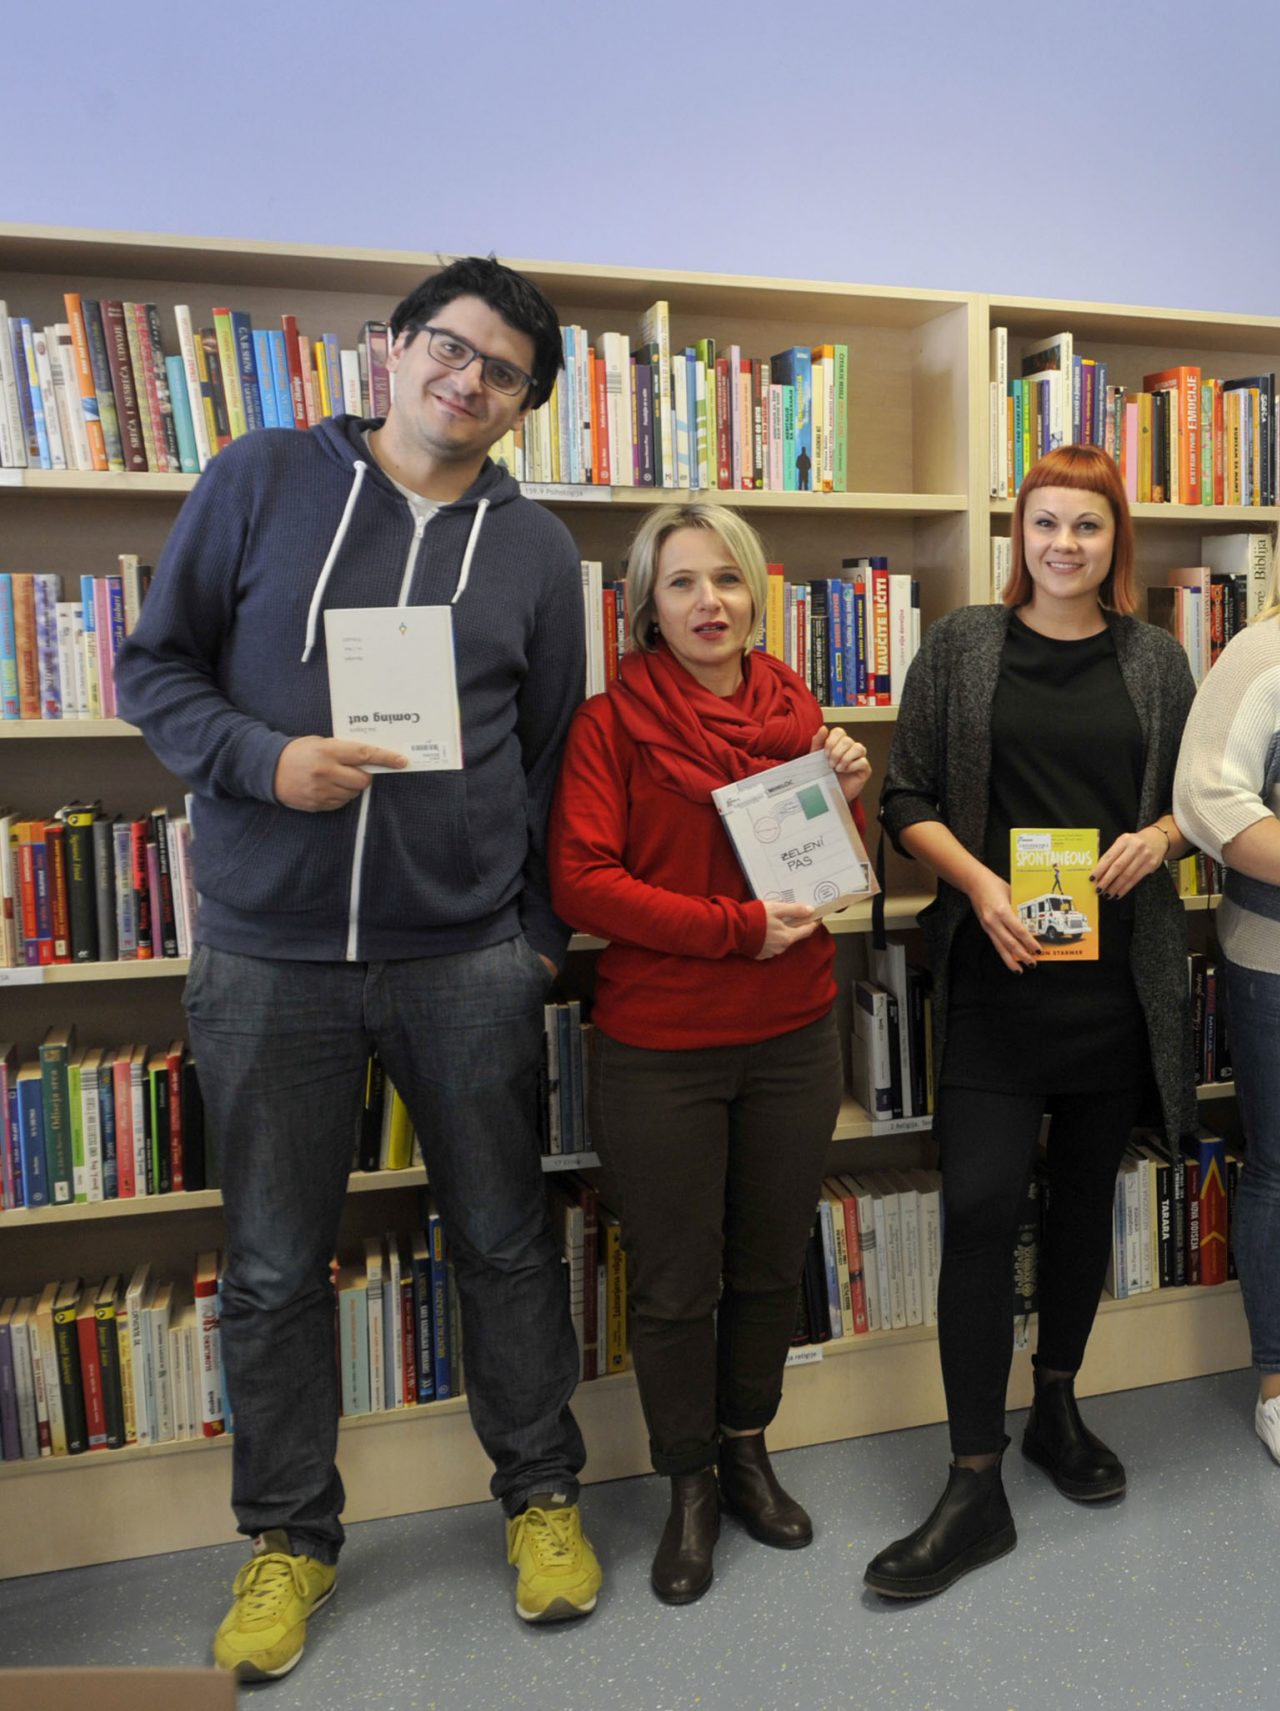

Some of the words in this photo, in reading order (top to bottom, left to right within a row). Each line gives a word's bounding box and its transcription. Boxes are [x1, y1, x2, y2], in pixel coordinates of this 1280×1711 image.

[118, 365, 132, 407] NESREĆA
[1187, 375, 1197, 430] EMOCIJE
[128, 419, 139, 448] SREĆA
[1253, 539, 1267, 581] Biblija
[874, 578, 886, 613] UČITI
[874, 617, 888, 675] NAUČITE
[348, 715, 369, 725] out
[372, 712, 420, 724] Coming
[787, 856, 814, 871] PAS
[1015, 850, 1093, 866] SPONTANEOUS
[50, 1093, 61, 1130] Odiseja
[1161, 1199, 1170, 1240] TARARA
[1190, 1201, 1199, 1219] NOVA
[1190, 1221, 1199, 1250] ODISEJA
